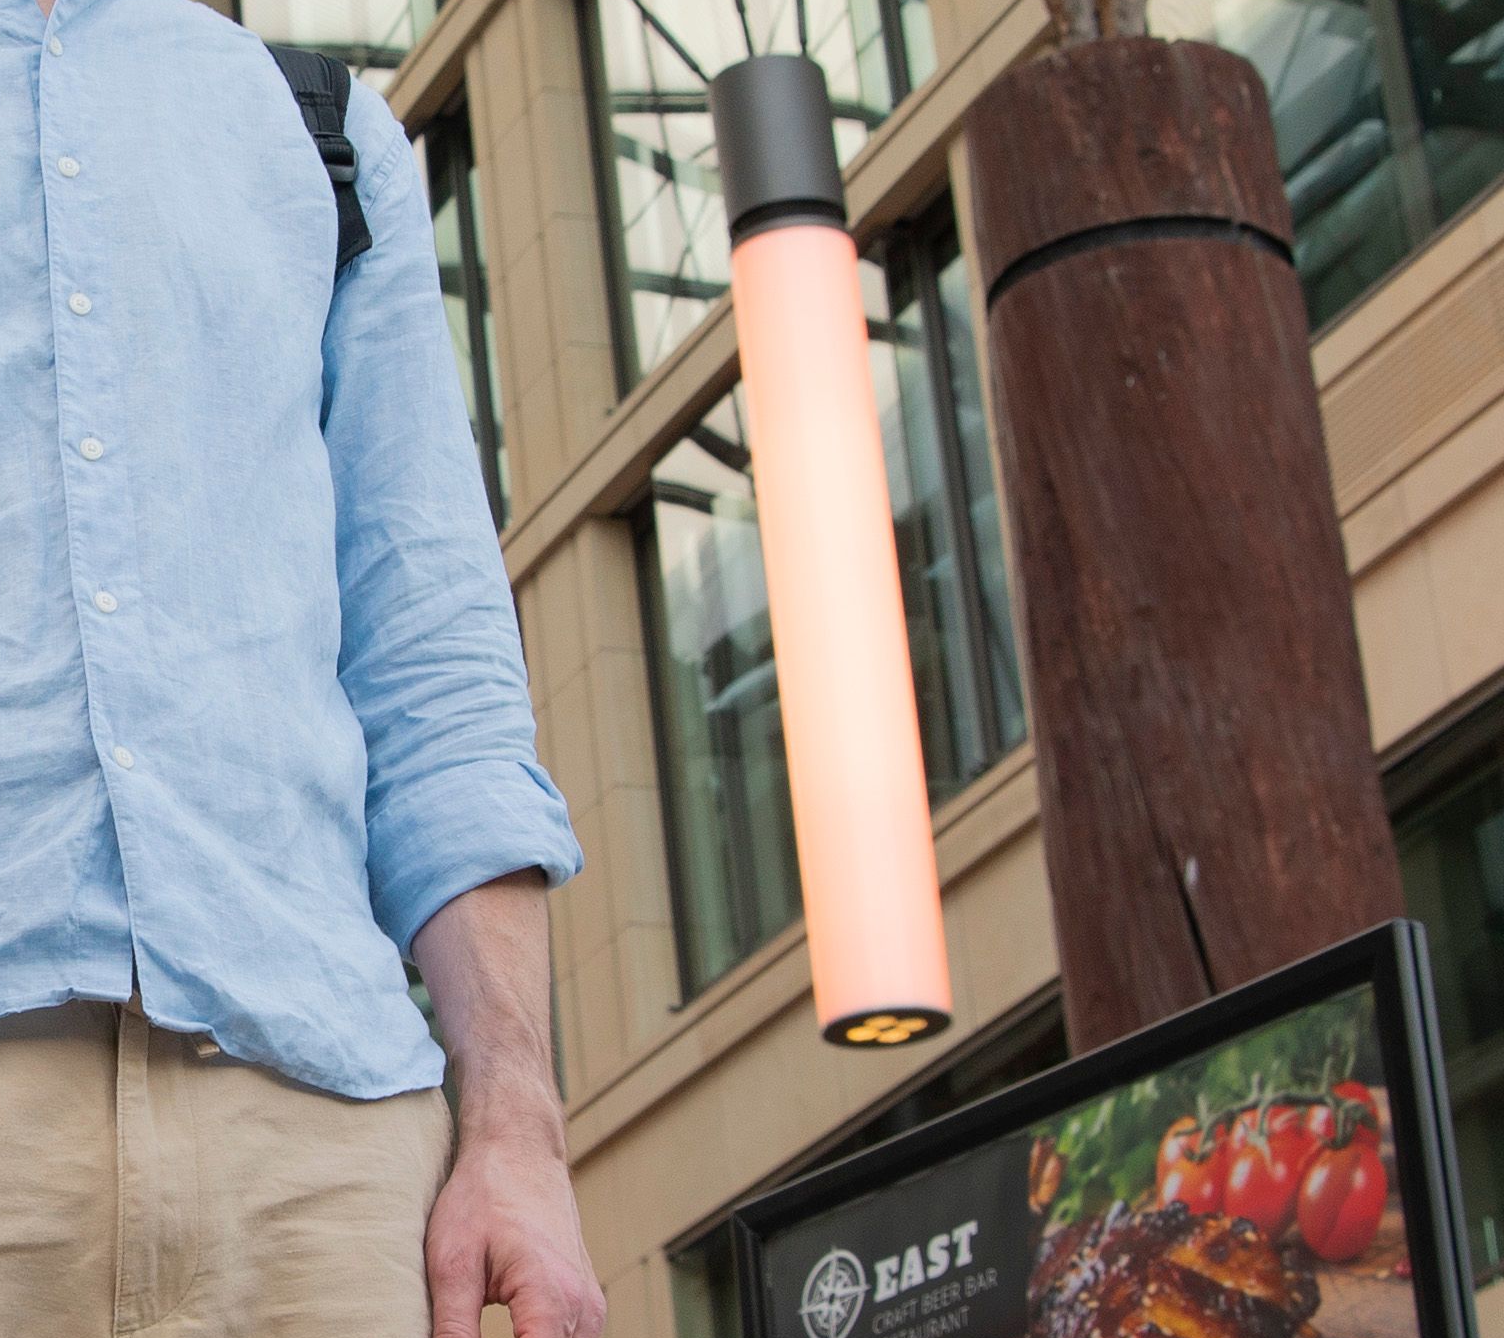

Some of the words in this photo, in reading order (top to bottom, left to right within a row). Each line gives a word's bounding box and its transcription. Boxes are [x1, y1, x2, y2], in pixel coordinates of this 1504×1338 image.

[873, 1219, 979, 1303] EAST
[871, 1297, 918, 1335] CRAFT
[921, 1281, 962, 1315] BEER
[964, 1267, 999, 1298] BAR
